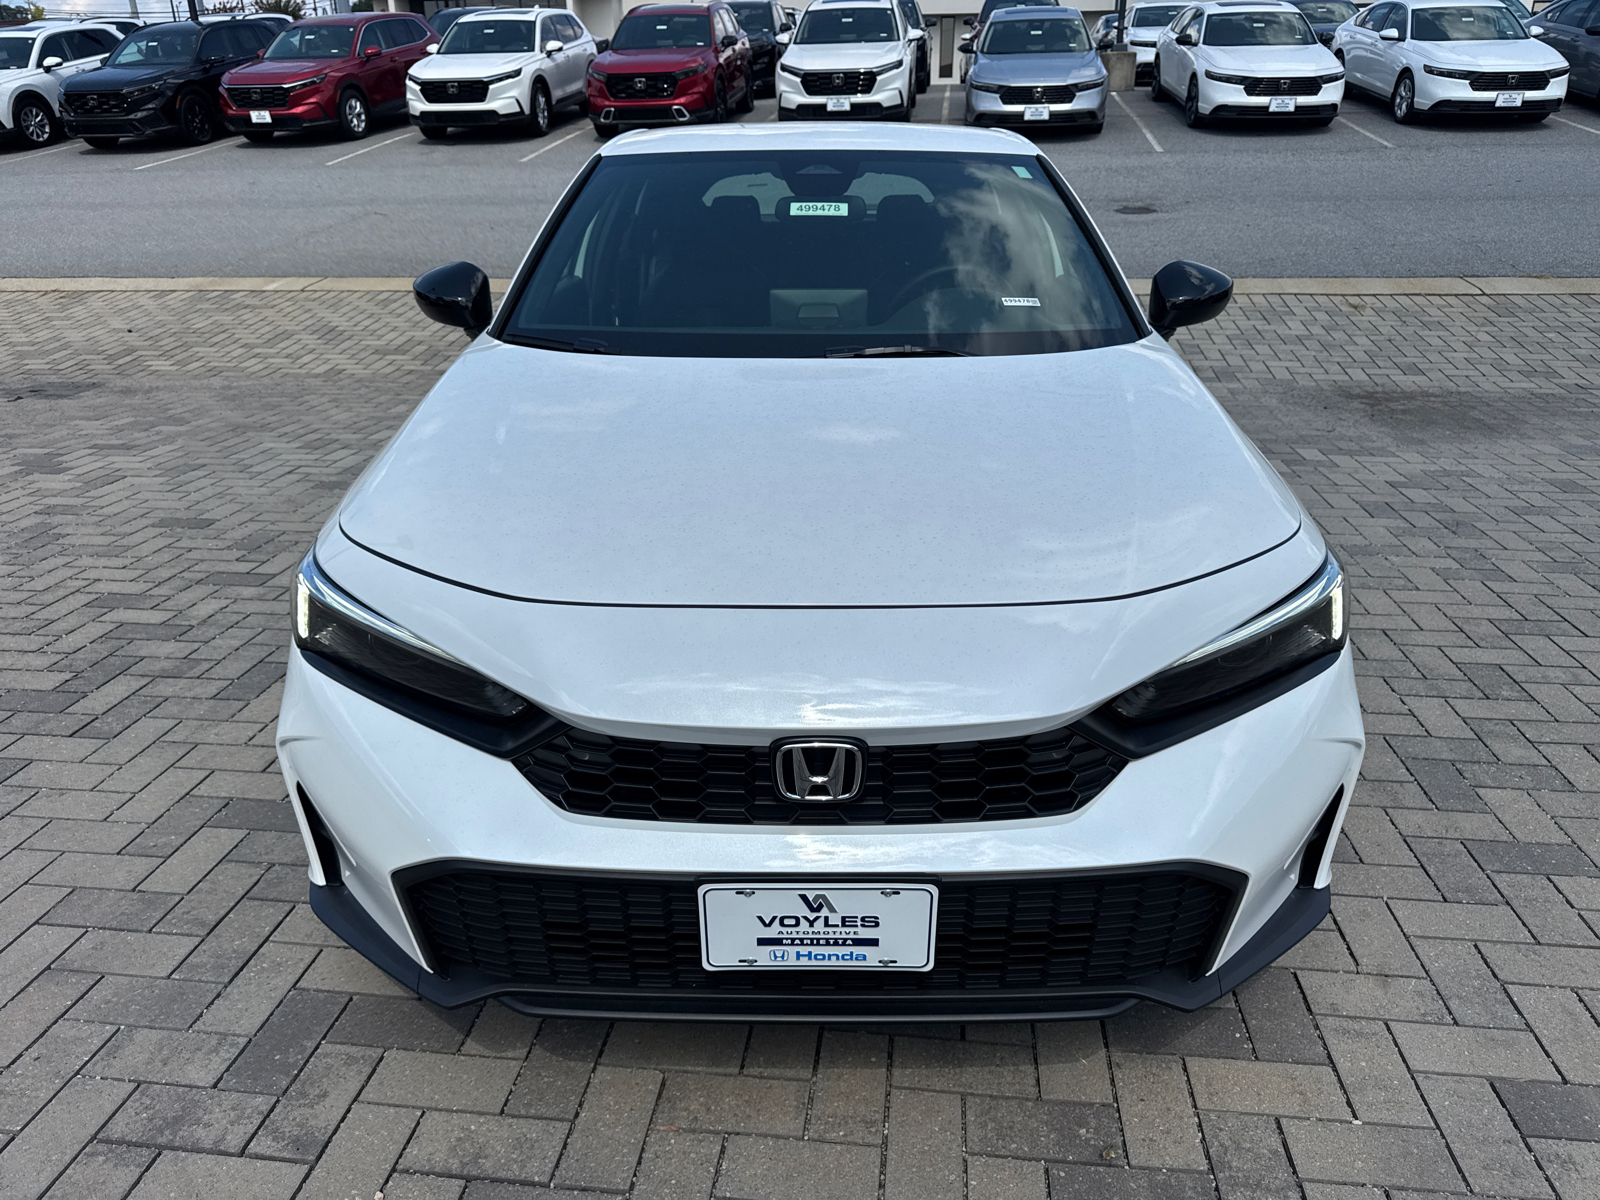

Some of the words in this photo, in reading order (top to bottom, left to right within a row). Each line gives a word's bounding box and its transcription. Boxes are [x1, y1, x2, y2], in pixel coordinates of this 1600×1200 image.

[796, 204, 841, 212] 499478
[756, 915, 880, 928] VOYLES
[795, 950, 867, 961] Honda
